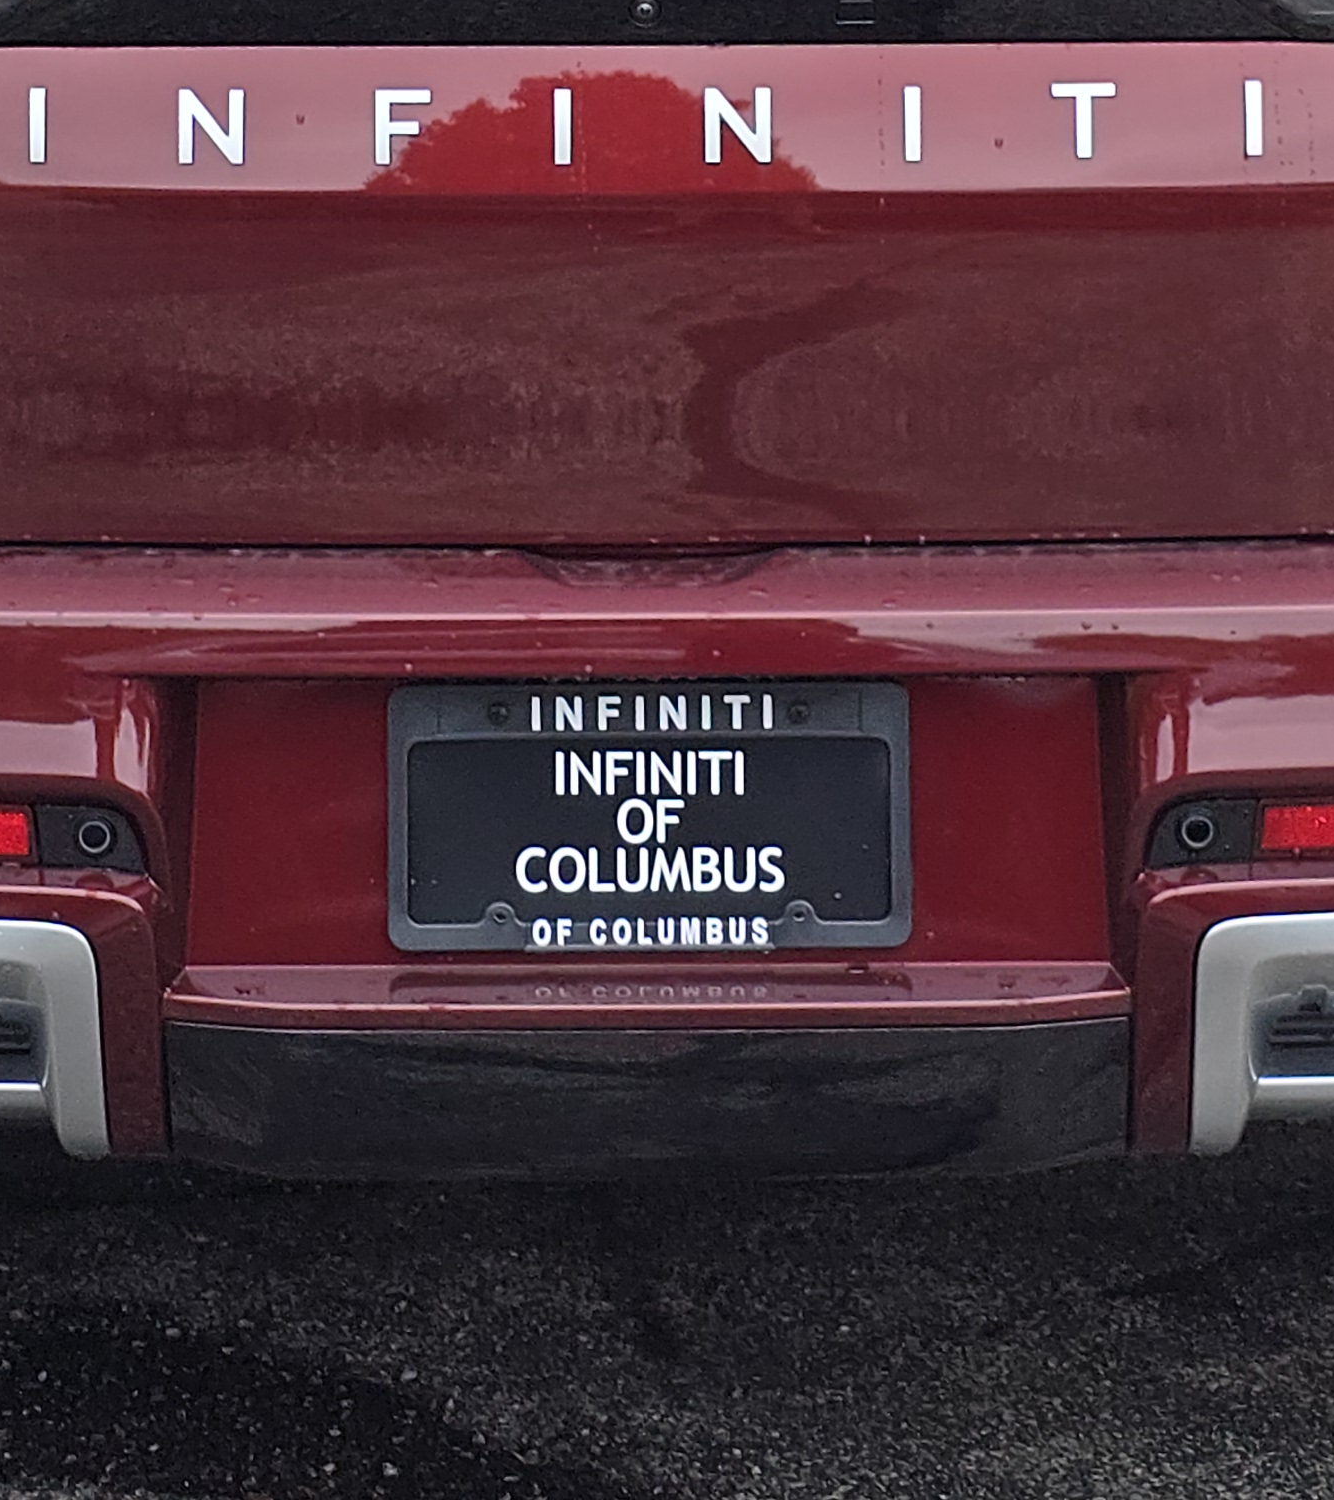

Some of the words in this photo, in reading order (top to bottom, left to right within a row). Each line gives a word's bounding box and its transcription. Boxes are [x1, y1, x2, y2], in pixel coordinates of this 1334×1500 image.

[29, 80, 1264, 165] INFINITI
[530, 694, 774, 732] INFINITI
[554, 750, 746, 796] INFINITI
[616, 799, 685, 844] OF
[515, 846, 786, 894] COLUMBUS
[531, 918, 573, 947] OF
[589, 916, 770, 946] COLUMBUS
